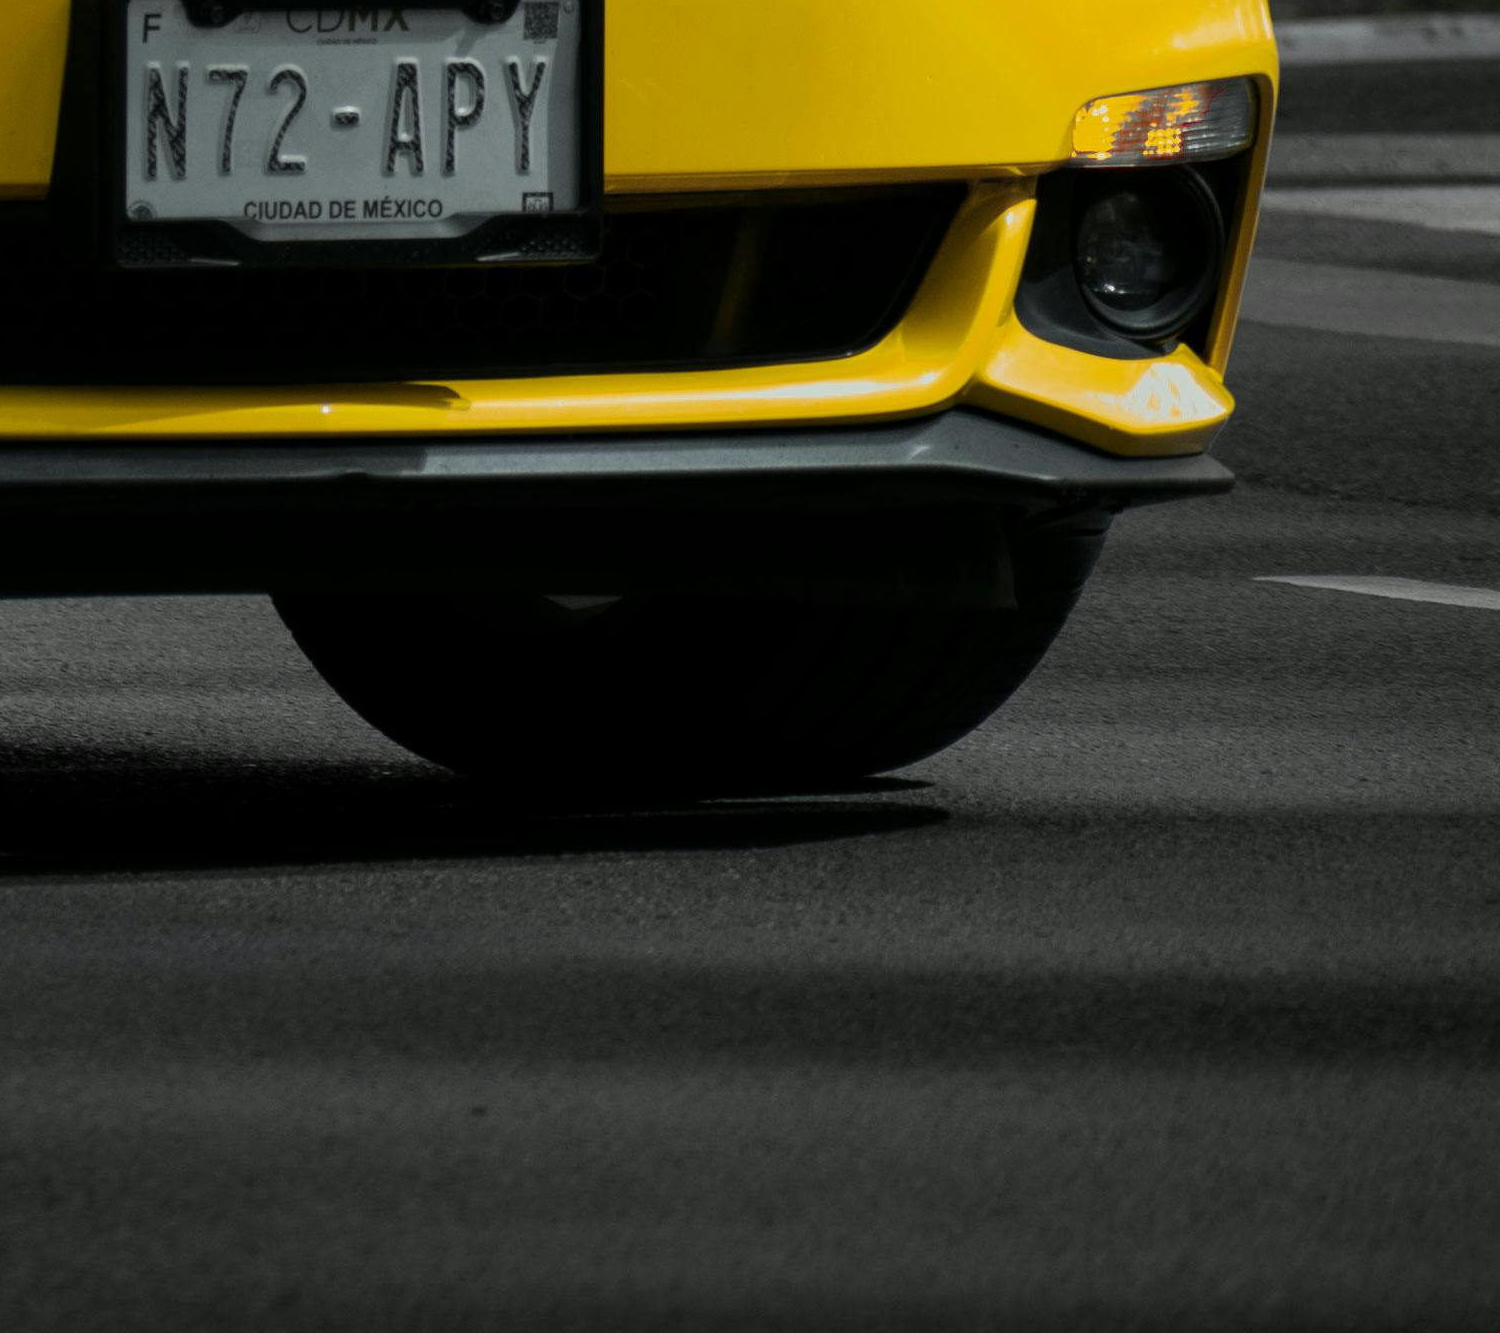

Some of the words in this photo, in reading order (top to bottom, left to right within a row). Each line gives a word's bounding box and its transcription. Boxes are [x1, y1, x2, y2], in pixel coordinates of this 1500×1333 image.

[142, 13, 162, 43] F
[145, 57, 548, 181] N72-APY
[243, 200, 323, 220] CIUDAD
[328, 199, 356, 219] DE
[362, 195, 443, 219] MÉXICO
